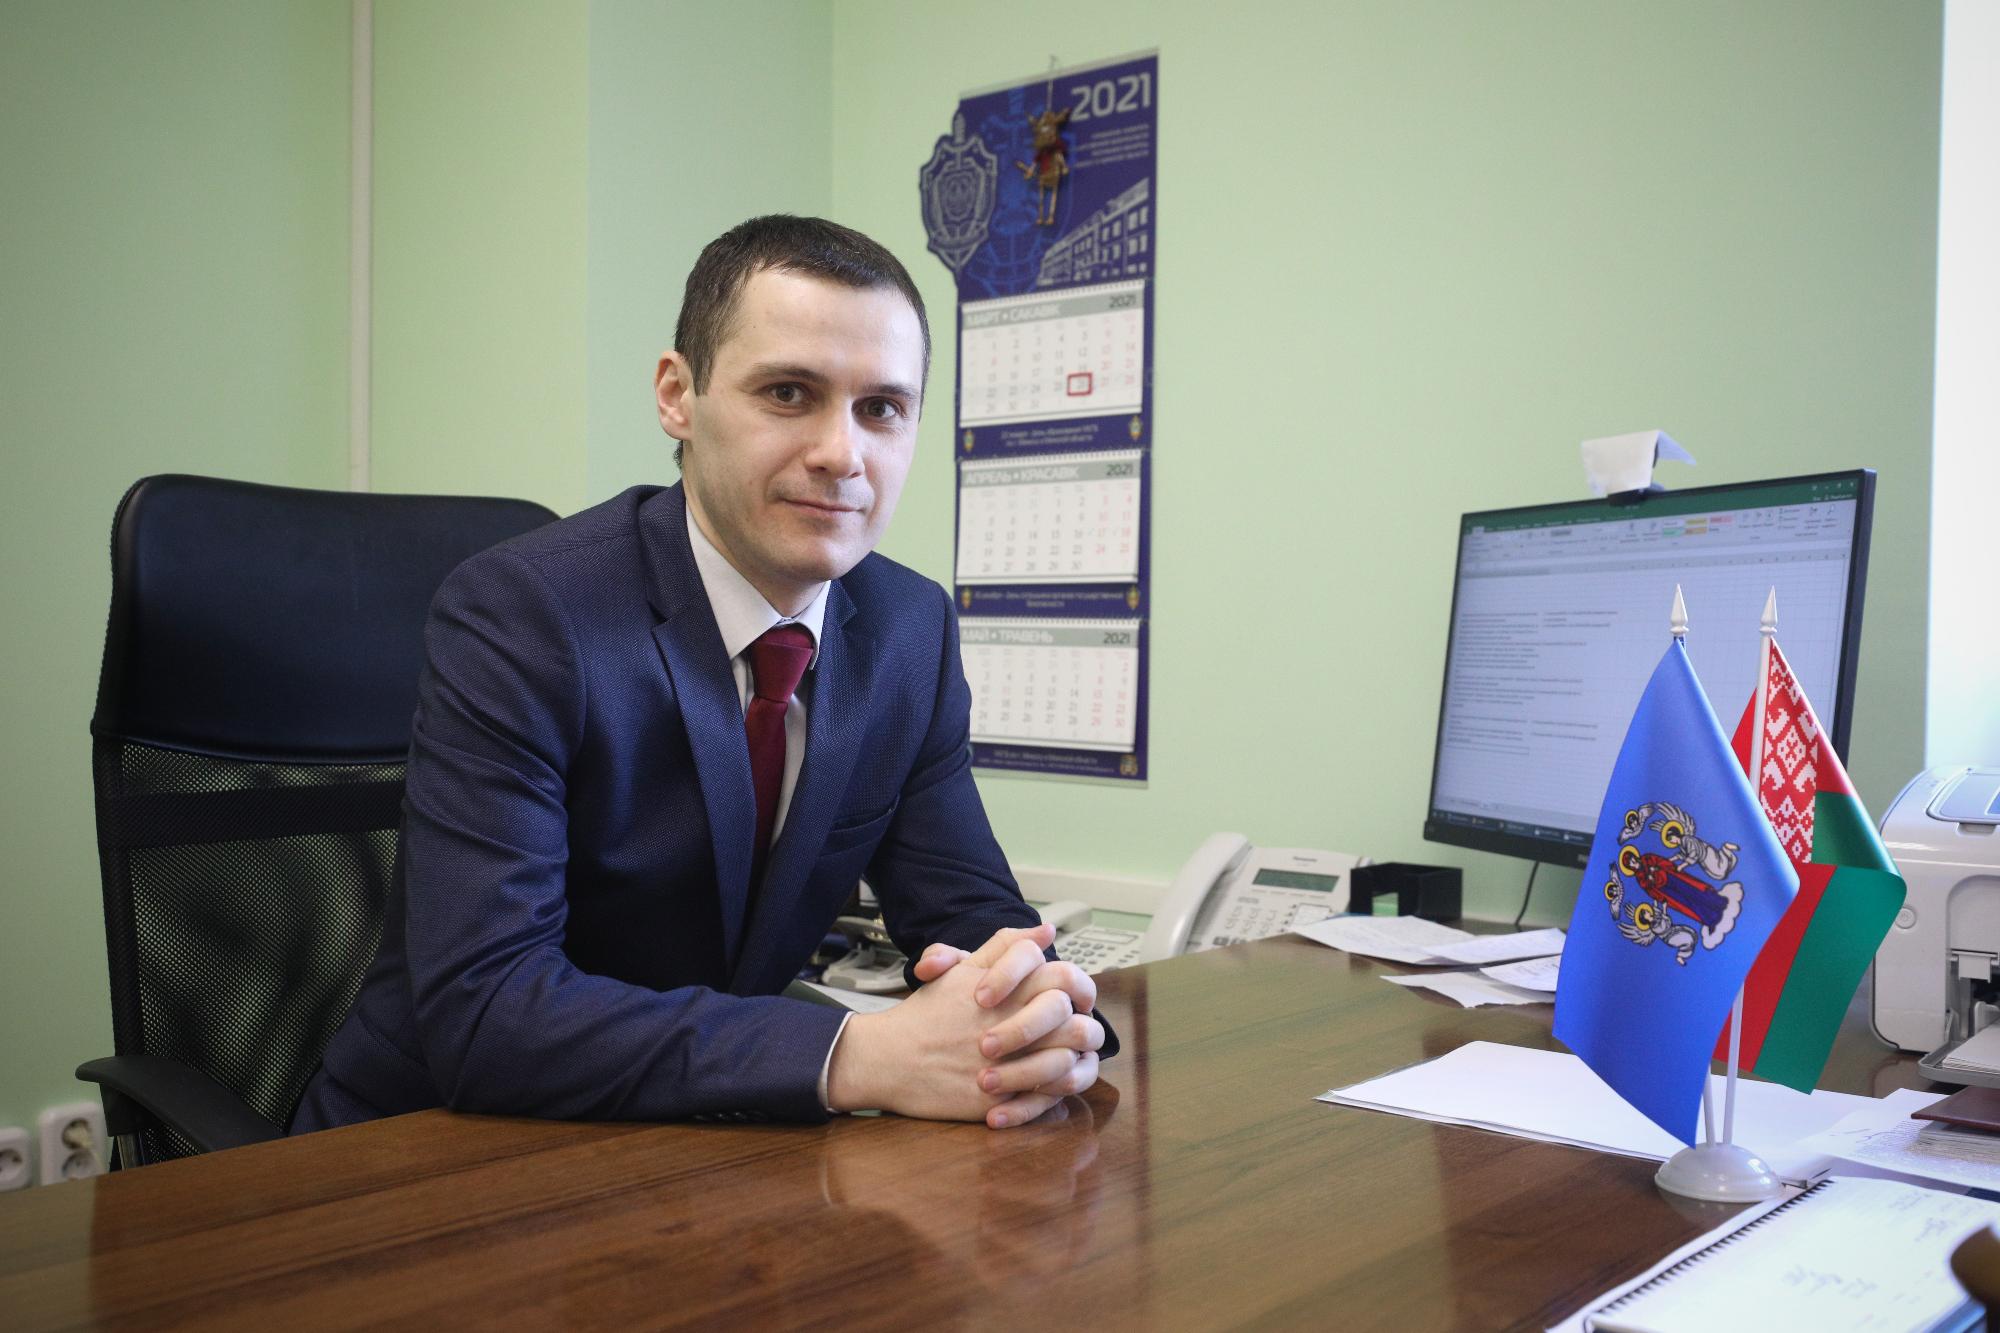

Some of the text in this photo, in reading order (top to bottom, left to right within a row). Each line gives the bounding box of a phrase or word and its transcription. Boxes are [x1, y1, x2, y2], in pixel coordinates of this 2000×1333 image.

[1070, 72, 1151, 122] 2021
[1109, 294, 1136, 309] 2021
[1106, 463, 1133, 476] 2021
[1103, 632, 1130, 644] 2021
